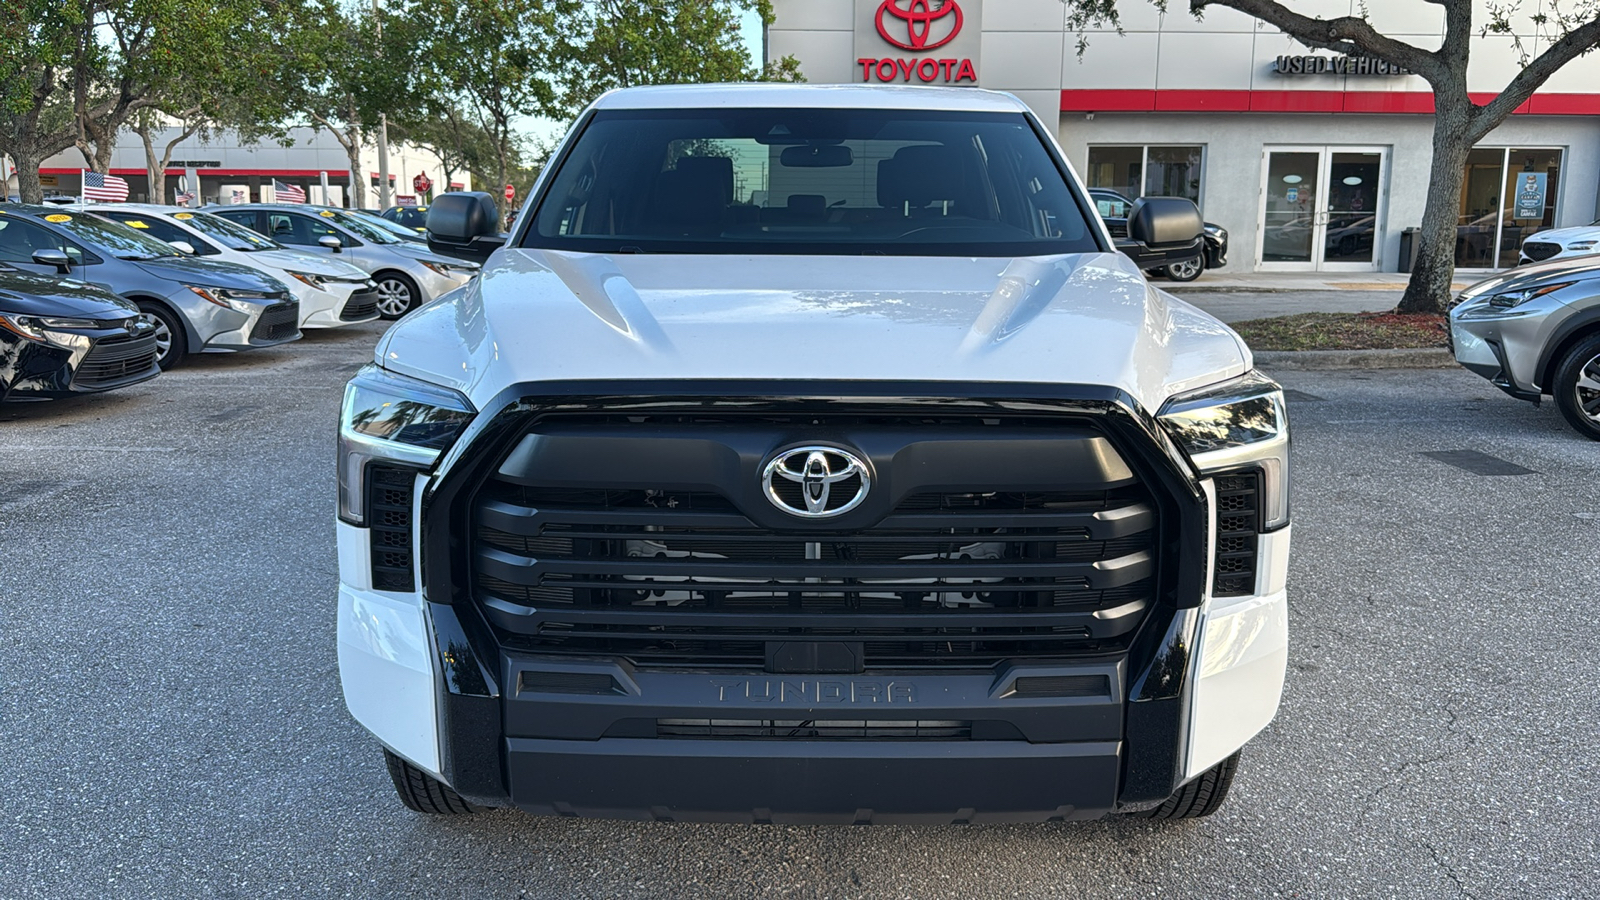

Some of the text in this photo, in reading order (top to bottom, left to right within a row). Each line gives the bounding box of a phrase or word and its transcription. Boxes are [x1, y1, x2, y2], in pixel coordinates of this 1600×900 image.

[857, 58, 977, 82] TOYOTA
[1277, 55, 1327, 74] USED
[710, 680, 918, 703] TUNDRA
